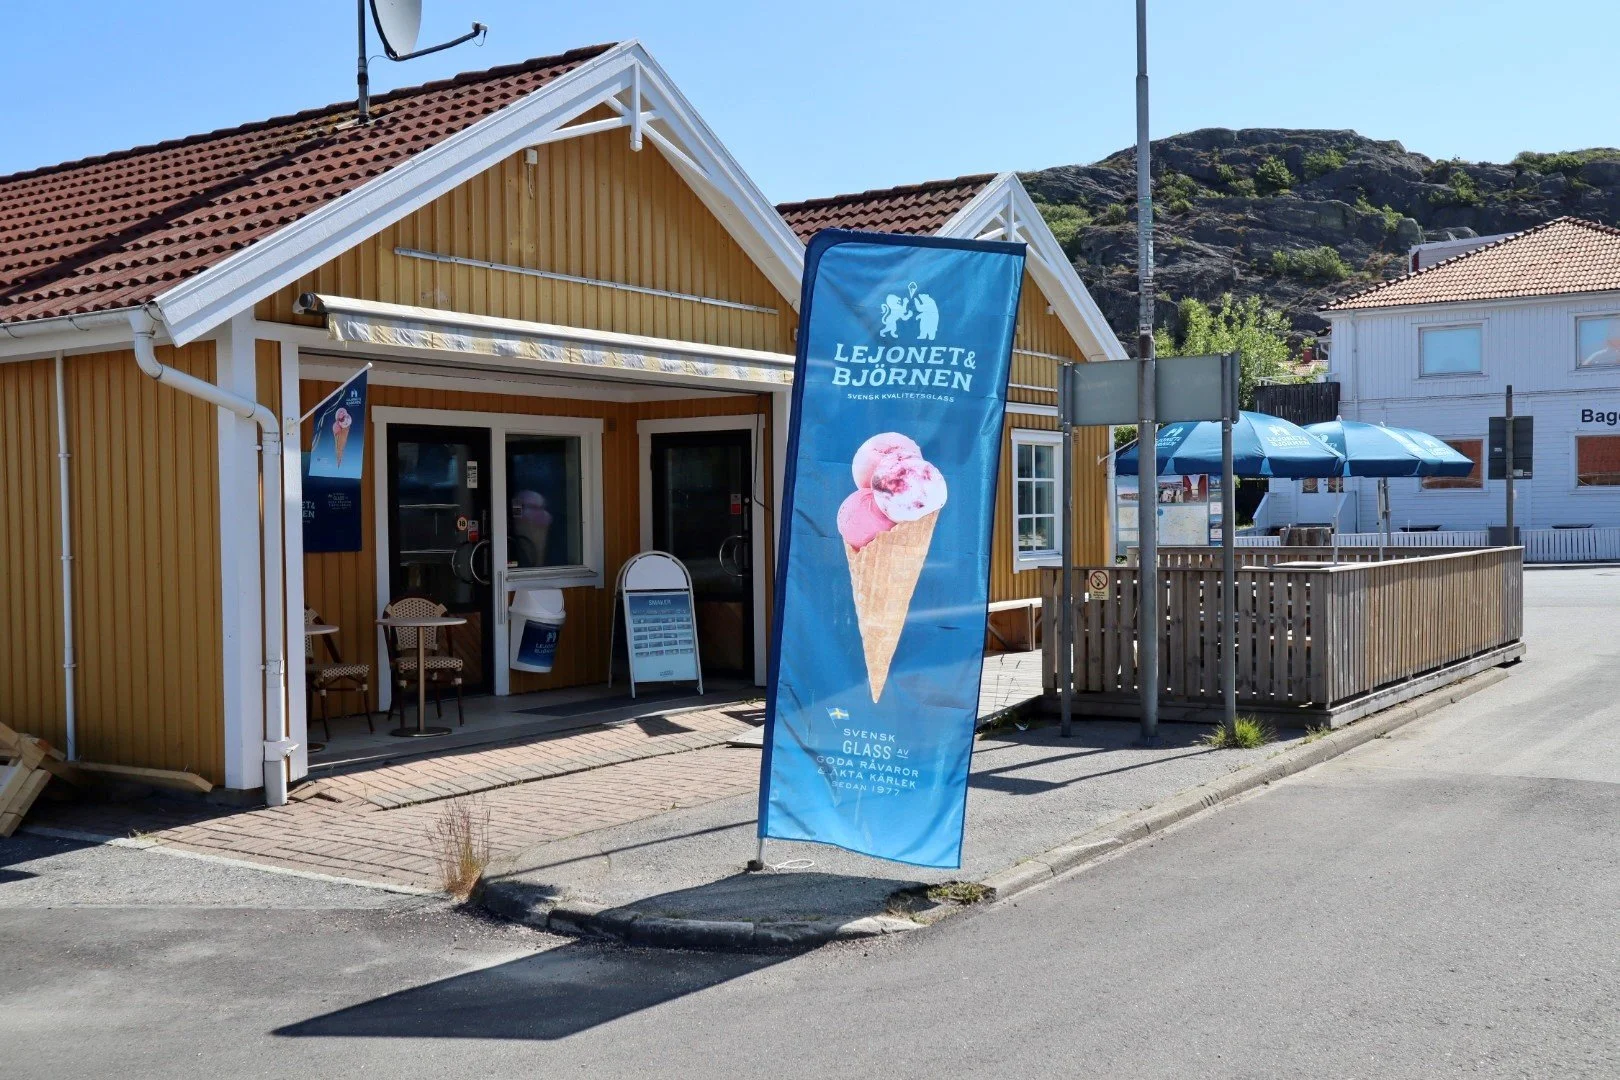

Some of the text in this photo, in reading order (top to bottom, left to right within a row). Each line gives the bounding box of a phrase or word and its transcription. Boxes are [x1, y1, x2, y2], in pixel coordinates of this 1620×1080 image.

[834, 343, 977, 370] LEJONET&
[832, 364, 973, 392] BJÖRNEN
[881, 392, 954, 403] KVALITETSGLASS
[1581, 409, 1620, 426] Bag
[843, 728, 896, 743] SVENSK
[842, 740, 909, 760] GLASS AV
[816, 755, 919, 778] GODA RÅVAROR
[831, 780, 901, 797] SEDAN 1977
[869, 769, 916, 789] KÄRLEK
